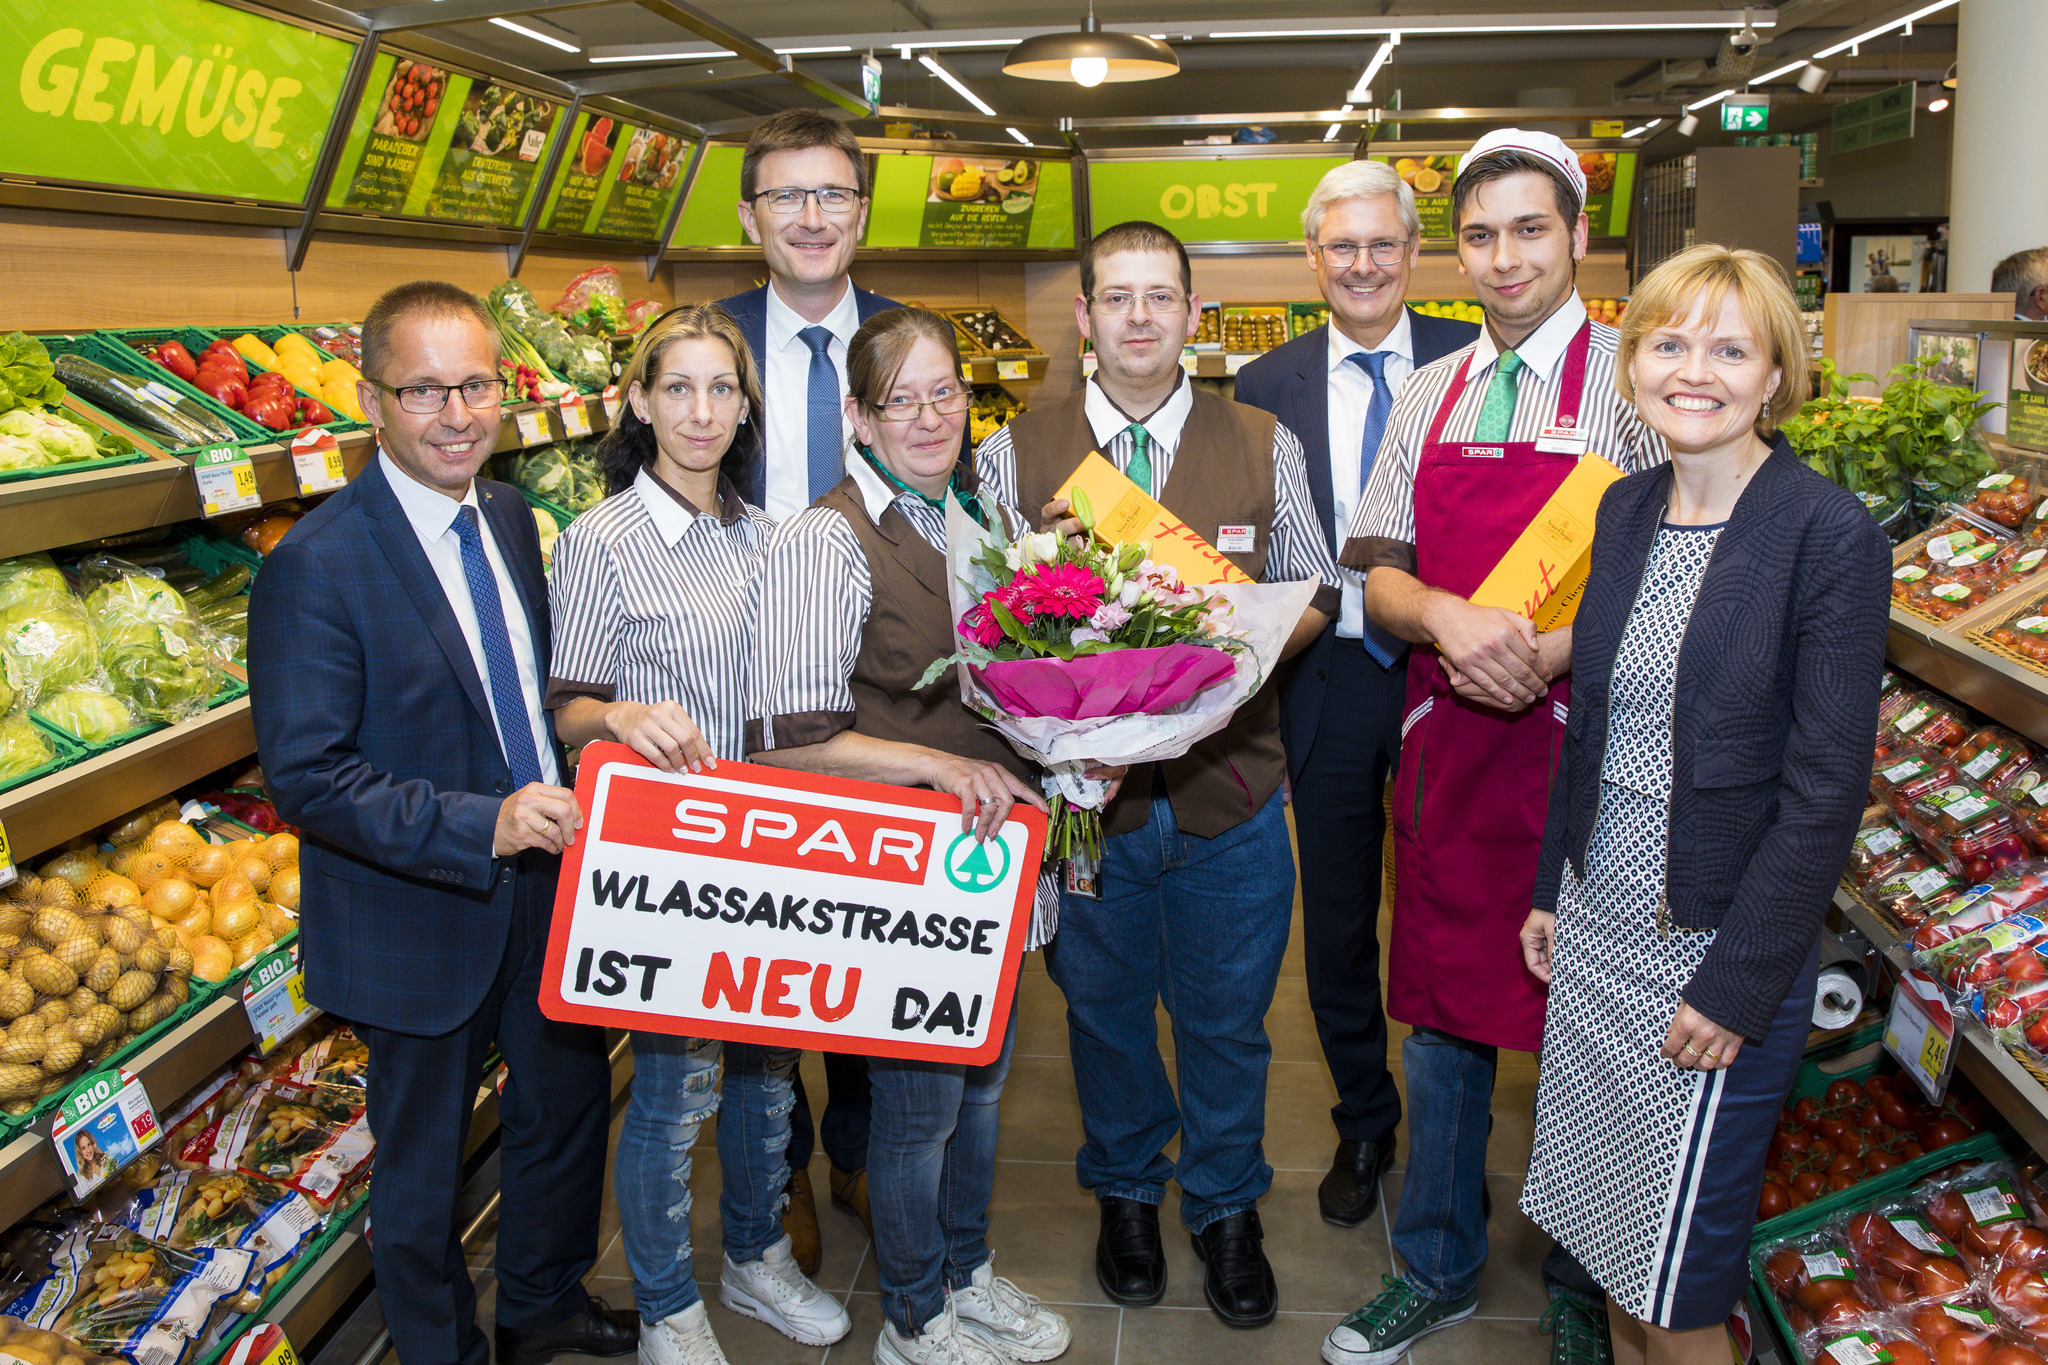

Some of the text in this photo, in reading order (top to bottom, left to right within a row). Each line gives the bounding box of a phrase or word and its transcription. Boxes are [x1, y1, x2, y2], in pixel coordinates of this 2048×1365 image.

[19, 27, 302, 149] GEMÜSE
[371, 138, 419, 157] PARADEISER
[364, 153, 416, 172] SIND KAISER!
[461, 169, 475, 181] AUS
[960, 204, 1000, 213] ZUGREIFEN
[1160, 183, 1277, 219] OBST
[1431, 198, 1449, 206] AUS
[949, 213, 1008, 222] AUF DIE REIFEN!
[210, 447, 232, 464] BIO
[238, 470, 254, 487] 1,49
[1562, 574, 1591, 607] Clicqu
[672, 798, 924, 872] SPAR
[592, 869, 1000, 955] WLASSAKSTRASSE
[258, 958, 284, 986] BIO
[294, 980, 304, 998] 1,1
[574, 948, 982, 1037] IST NEU DA!
[252, 1003, 264, 1014] SPAR
[254, 1002, 278, 1020] Zwiebel gelb
[74, 1080, 110, 1116] BIO
[133, 1113, 153, 1134] 1.19
[208, 1127, 216, 1139] kg
[14, 1304, 29, 1316] kg
